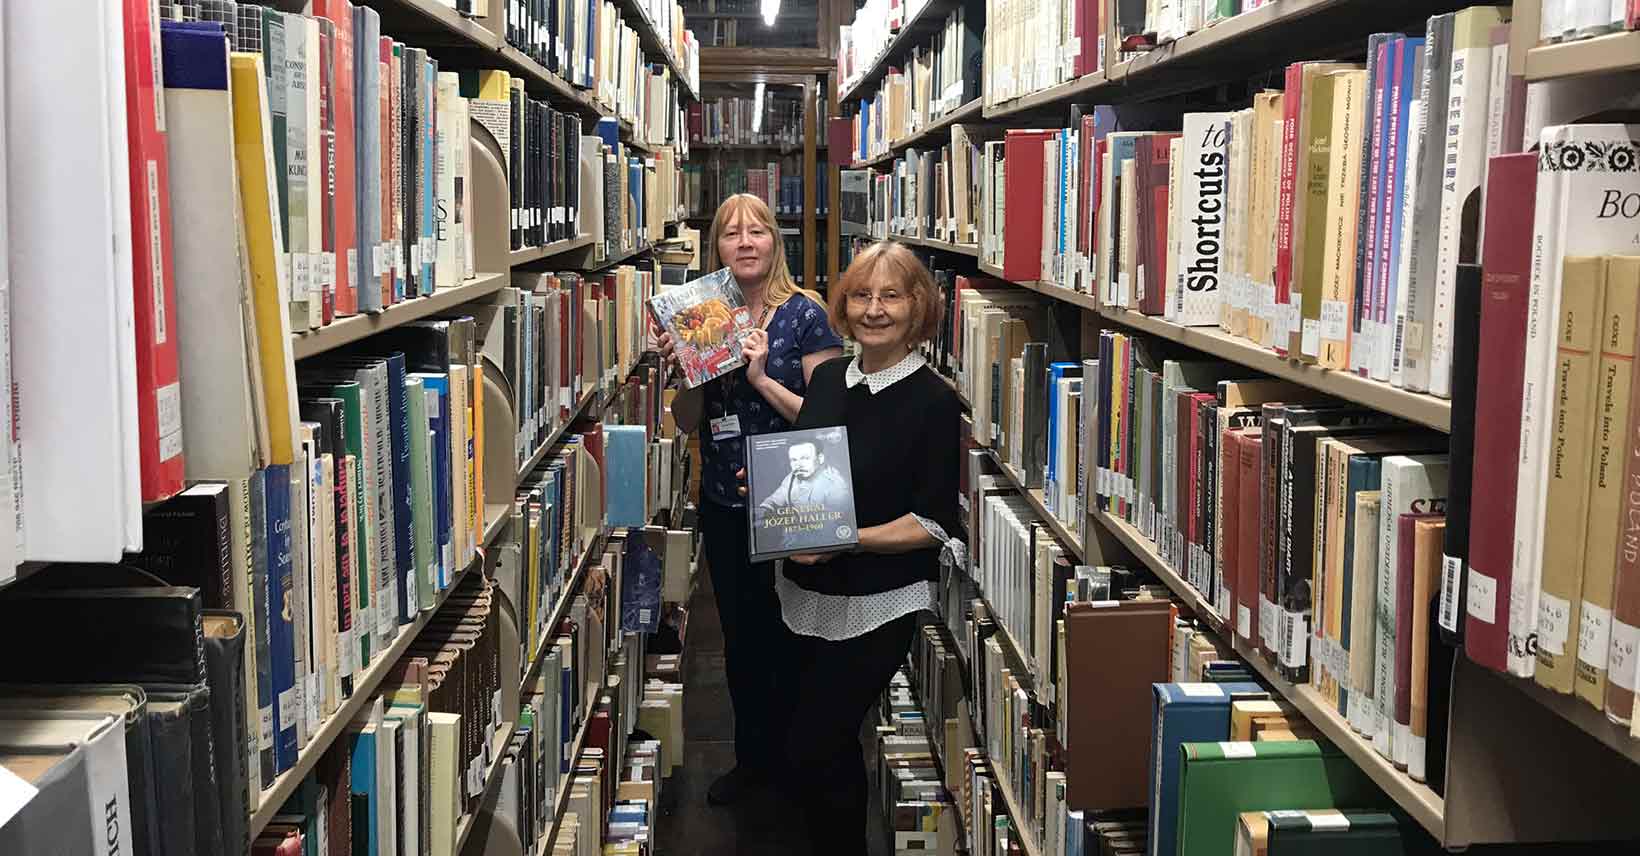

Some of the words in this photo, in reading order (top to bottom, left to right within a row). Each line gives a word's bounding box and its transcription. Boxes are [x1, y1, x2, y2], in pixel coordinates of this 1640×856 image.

[1453, 58, 1464, 84] MY
[1201, 123, 1227, 149] to
[1445, 96, 1461, 192] CENTURY
[1597, 189, 1640, 220] BO
[1187, 152, 1224, 292] Shortcuts
[1565, 311, 1574, 342] COXE
[1611, 314, 1620, 348] COXE
[1560, 360, 1571, 405] Travels
[1604, 365, 1617, 413] Travels
[1558, 407, 1568, 433] into
[1602, 416, 1612, 441] into
[1554, 437, 1564, 478] Poland
[1599, 445, 1610, 488] Poland
[764, 513, 797, 528] JÓZEF
[799, 511, 842, 523] HALLER
